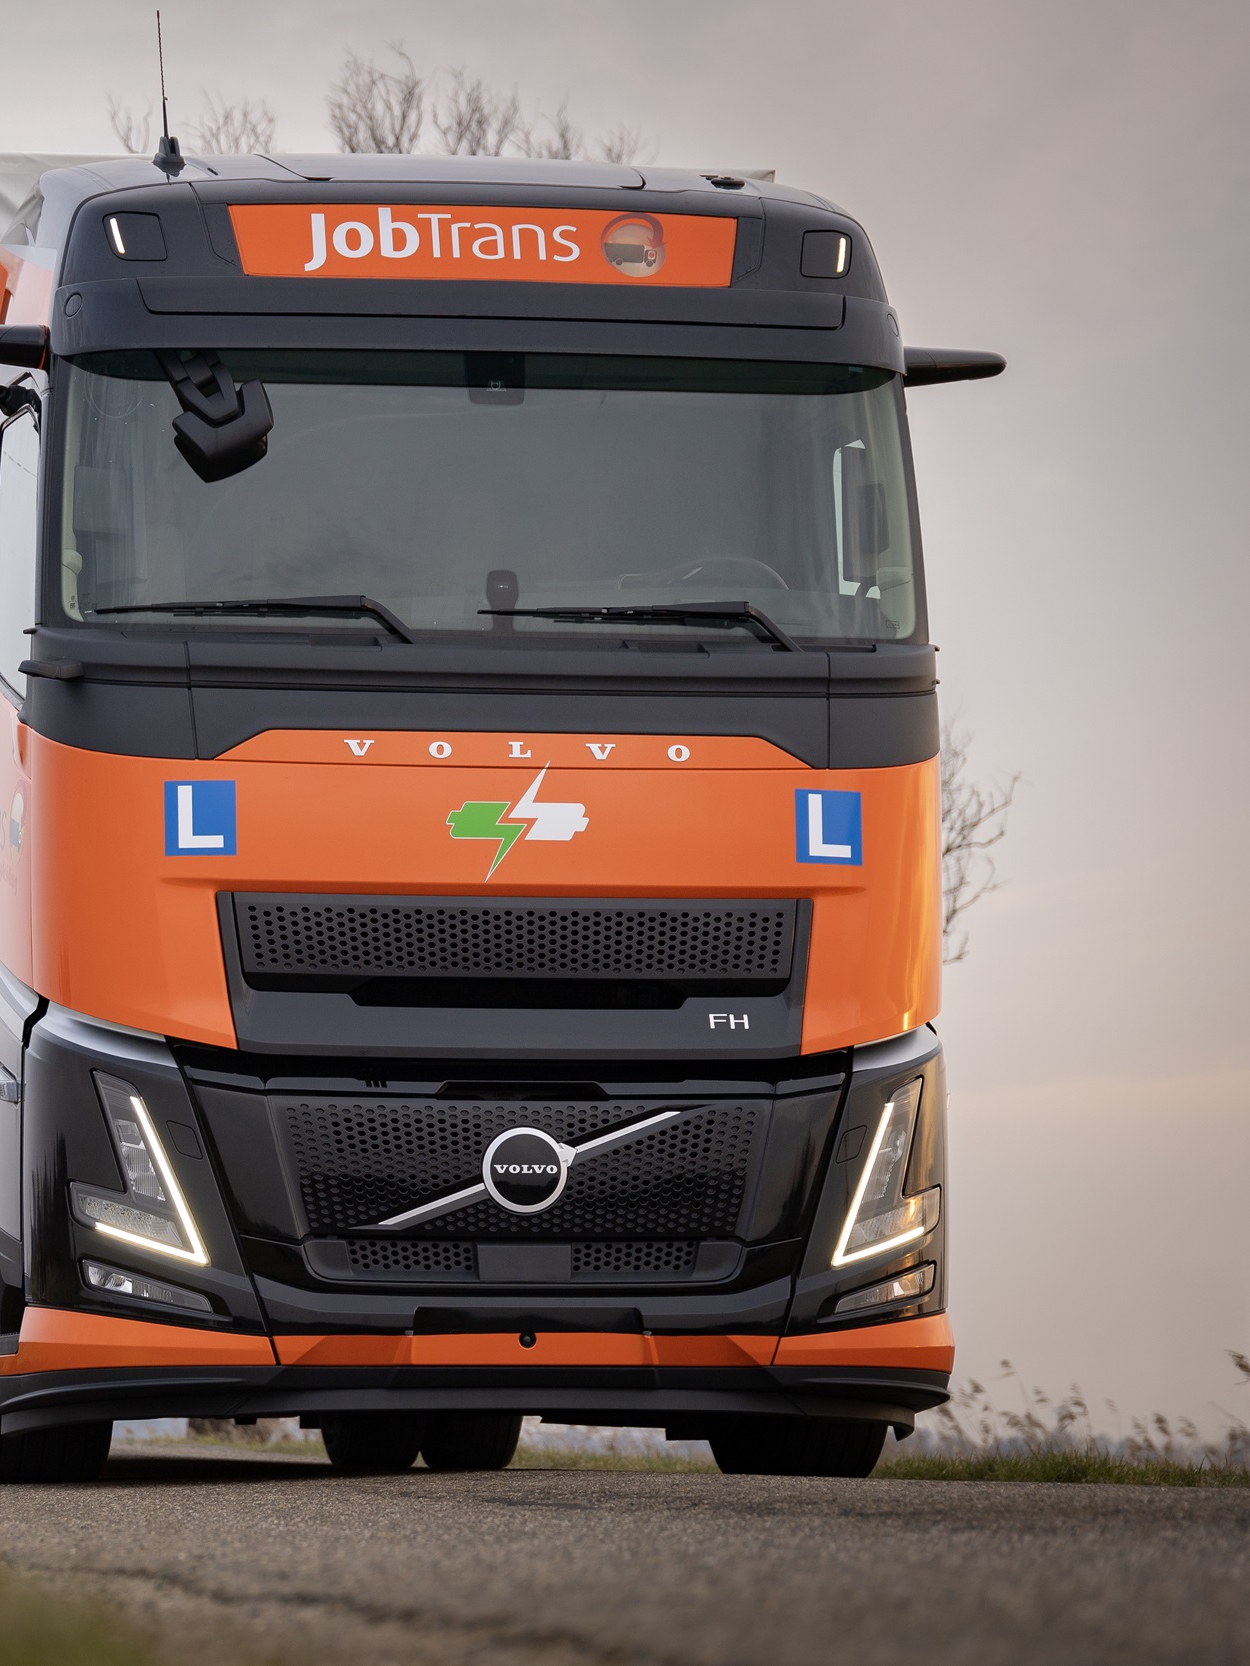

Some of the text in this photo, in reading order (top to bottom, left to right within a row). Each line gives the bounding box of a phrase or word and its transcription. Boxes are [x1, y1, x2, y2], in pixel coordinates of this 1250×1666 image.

[305, 207, 581, 271] JobTrans
[343, 739, 691, 762] VOLVO
[177, 785, 224, 849] L
[808, 793, 852, 858] L
[708, 1013, 750, 1030] FH
[493, 1164, 558, 1174] VOLVO
